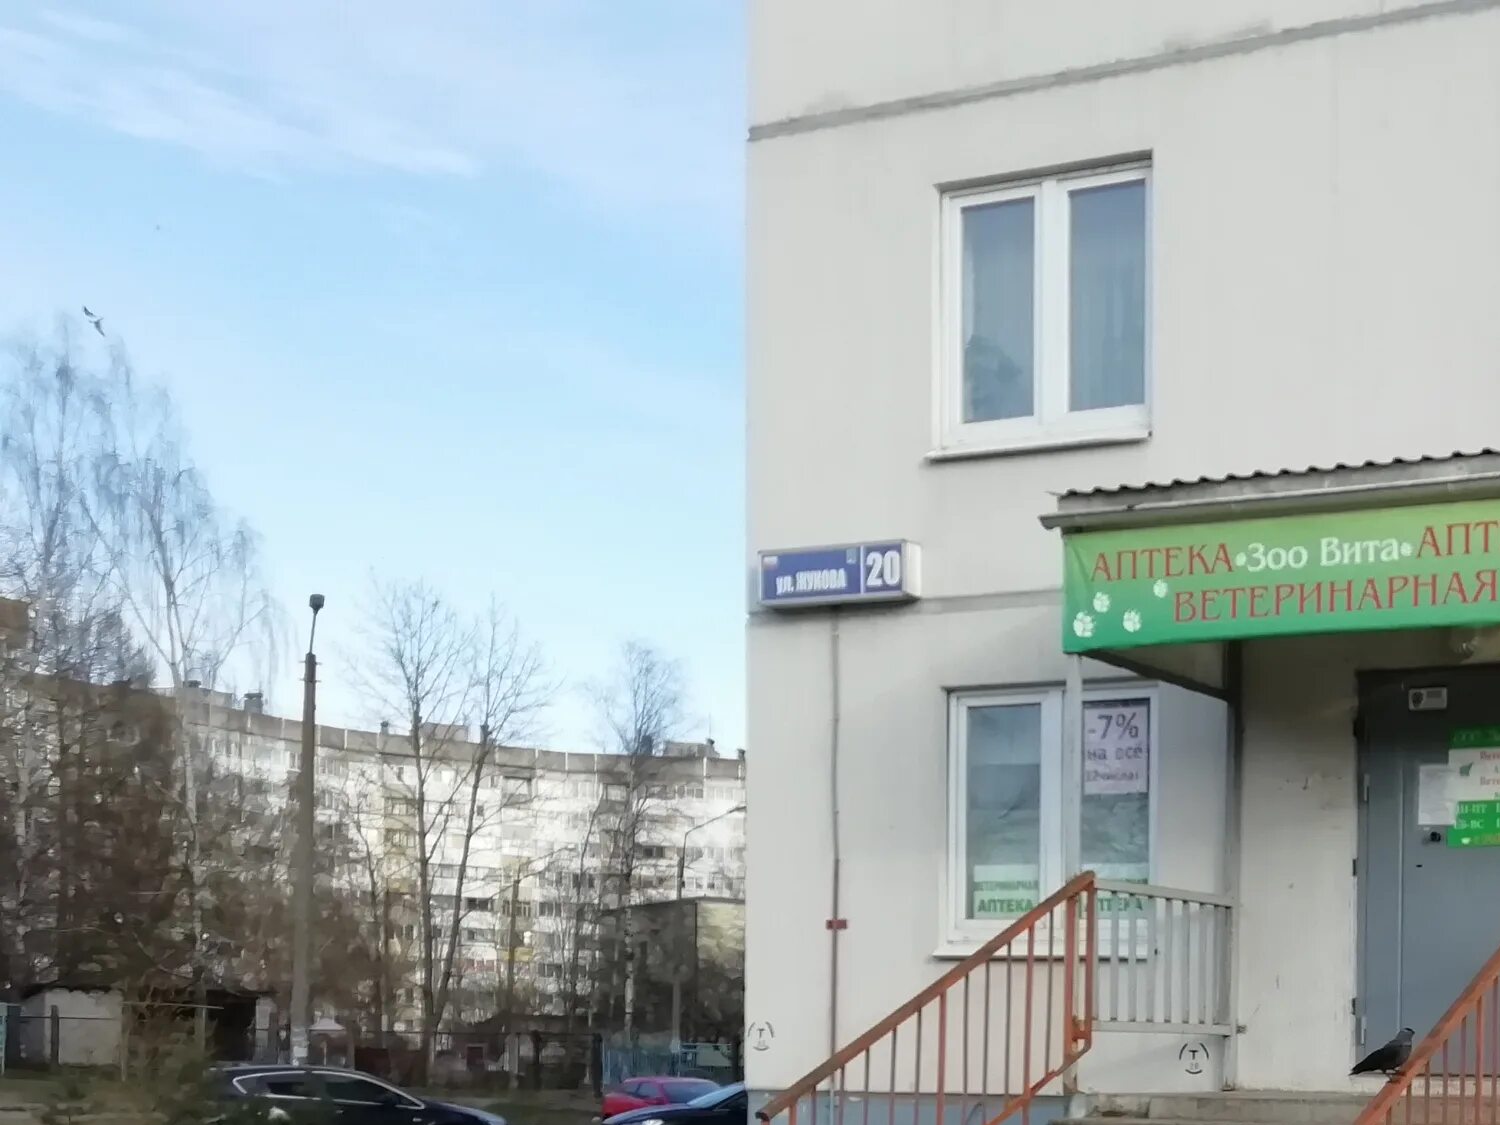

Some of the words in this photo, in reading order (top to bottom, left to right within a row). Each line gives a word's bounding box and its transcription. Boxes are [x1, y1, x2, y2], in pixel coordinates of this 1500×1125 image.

[796, 568, 846, 592] ЖУКОВА
[866, 550, 901, 587] 20
[1090, 542, 1233, 583] АПТЕКА
[1247, 542, 1308, 572] Зоо
[1320, 536, 1400, 567] Вита
[1174, 568, 1498, 624] ВЕТЕРИНАРНАЯ
[1087, 711, 1140, 741] -7%
